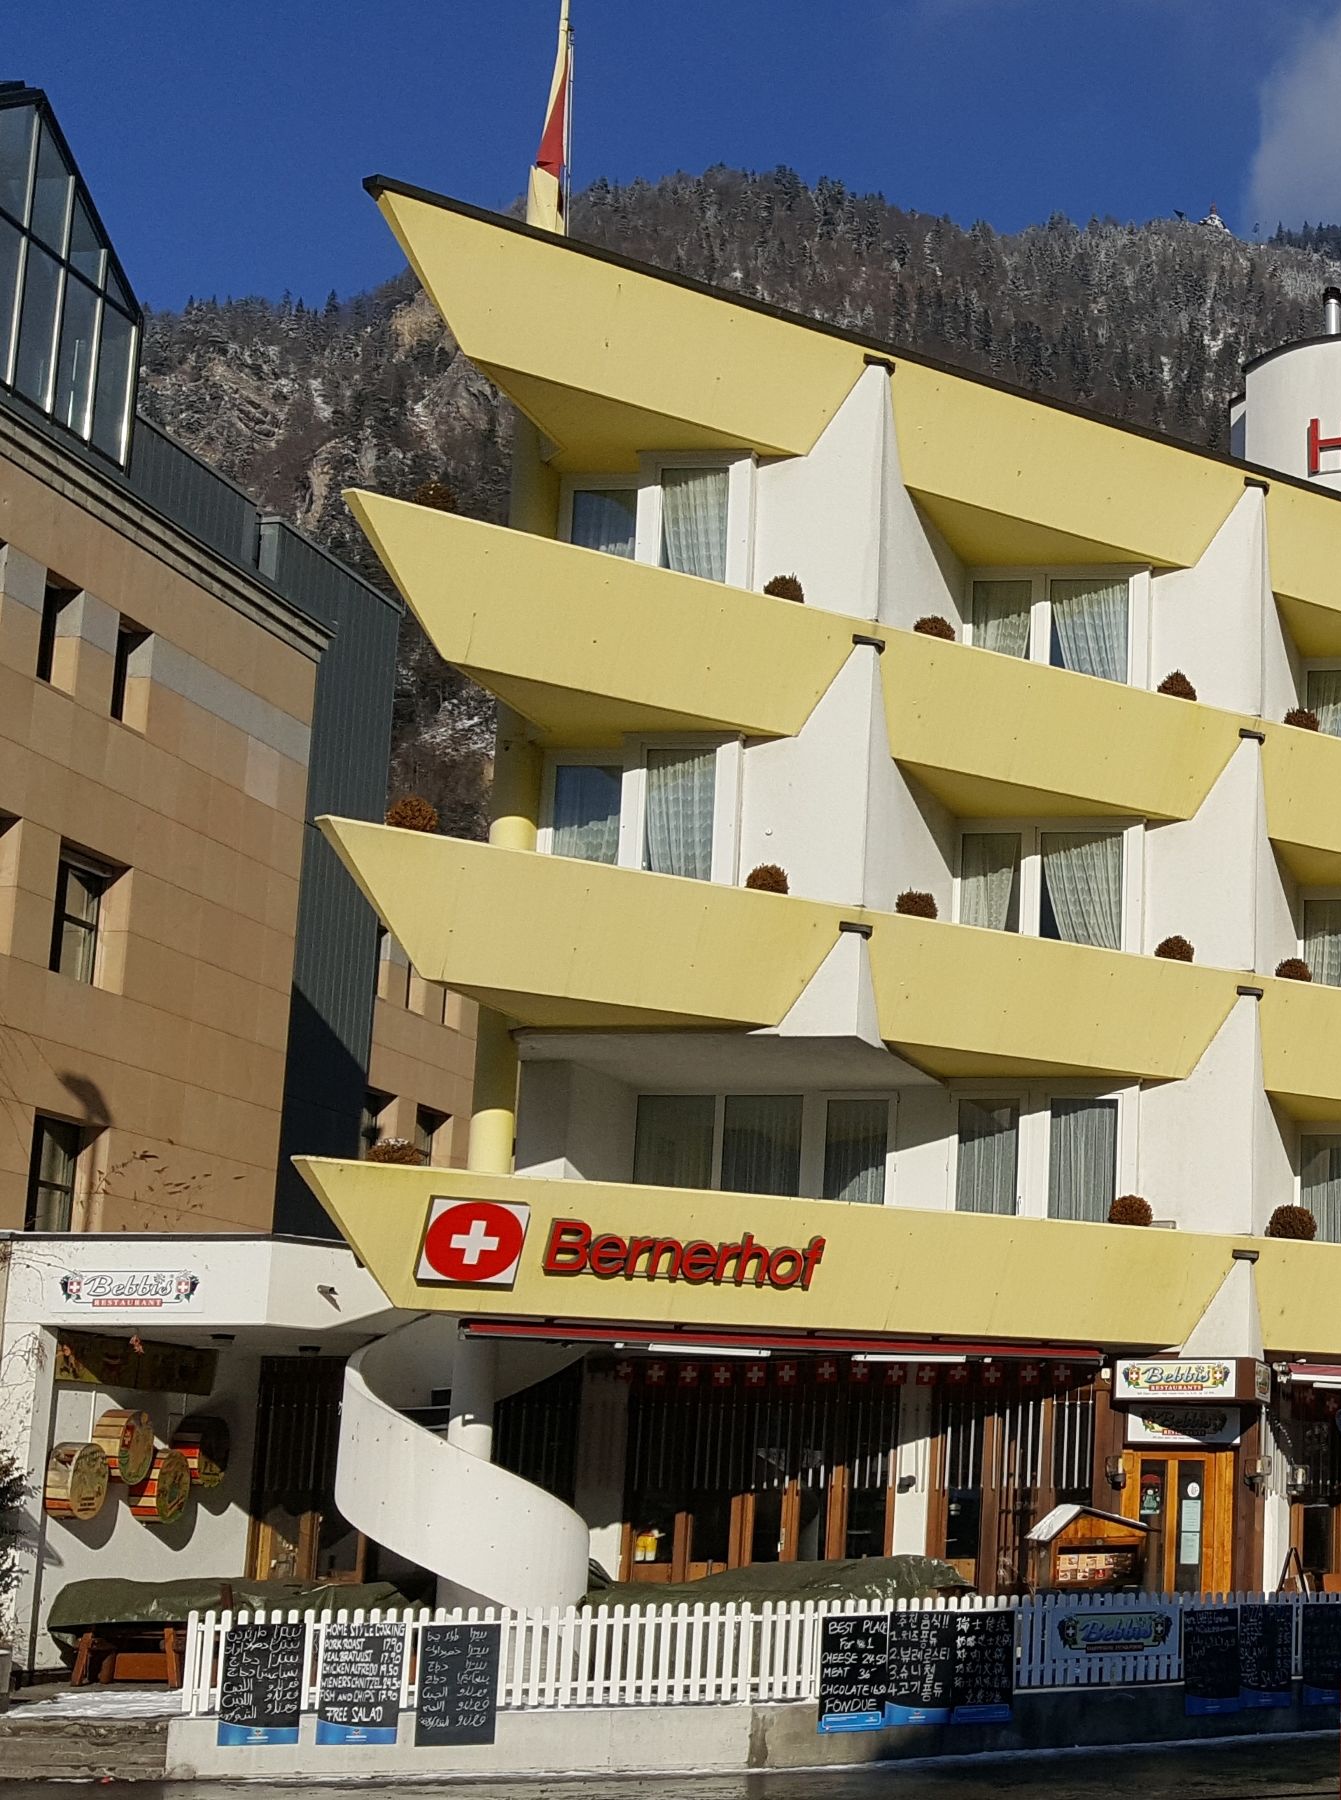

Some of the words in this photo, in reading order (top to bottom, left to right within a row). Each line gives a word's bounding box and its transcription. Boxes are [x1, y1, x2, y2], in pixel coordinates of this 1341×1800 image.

[543, 1218, 826, 1291] Bernerhof
[93, 1299, 162, 1307] RESTAURANT
[325, 1624, 348, 1637] HOME
[350, 1623, 374, 1637] STYLE
[828, 1621, 857, 1635] BEST
[862, 1620, 888, 1635] PLACE
[324, 1639, 341, 1650] PORK
[342, 1638, 365, 1650] ROAST
[383, 1638, 403, 1653] 17.90
[323, 1651, 339, 1662] VEAL
[821, 1652, 859, 1664] CHEESE
[322, 1663, 349, 1675] CHICKEN
[350, 1663, 378, 1675] ALFREDO
[822, 1667, 851, 1679] MEAT
[319, 1690, 335, 1701] FISH
[337, 1693, 353, 1701] AND
[353, 1690, 376, 1702] CHIPS
[824, 1697, 878, 1713] FONDUE
[324, 1707, 348, 1721] FREE
[351, 1706, 383, 1722] SALAD
